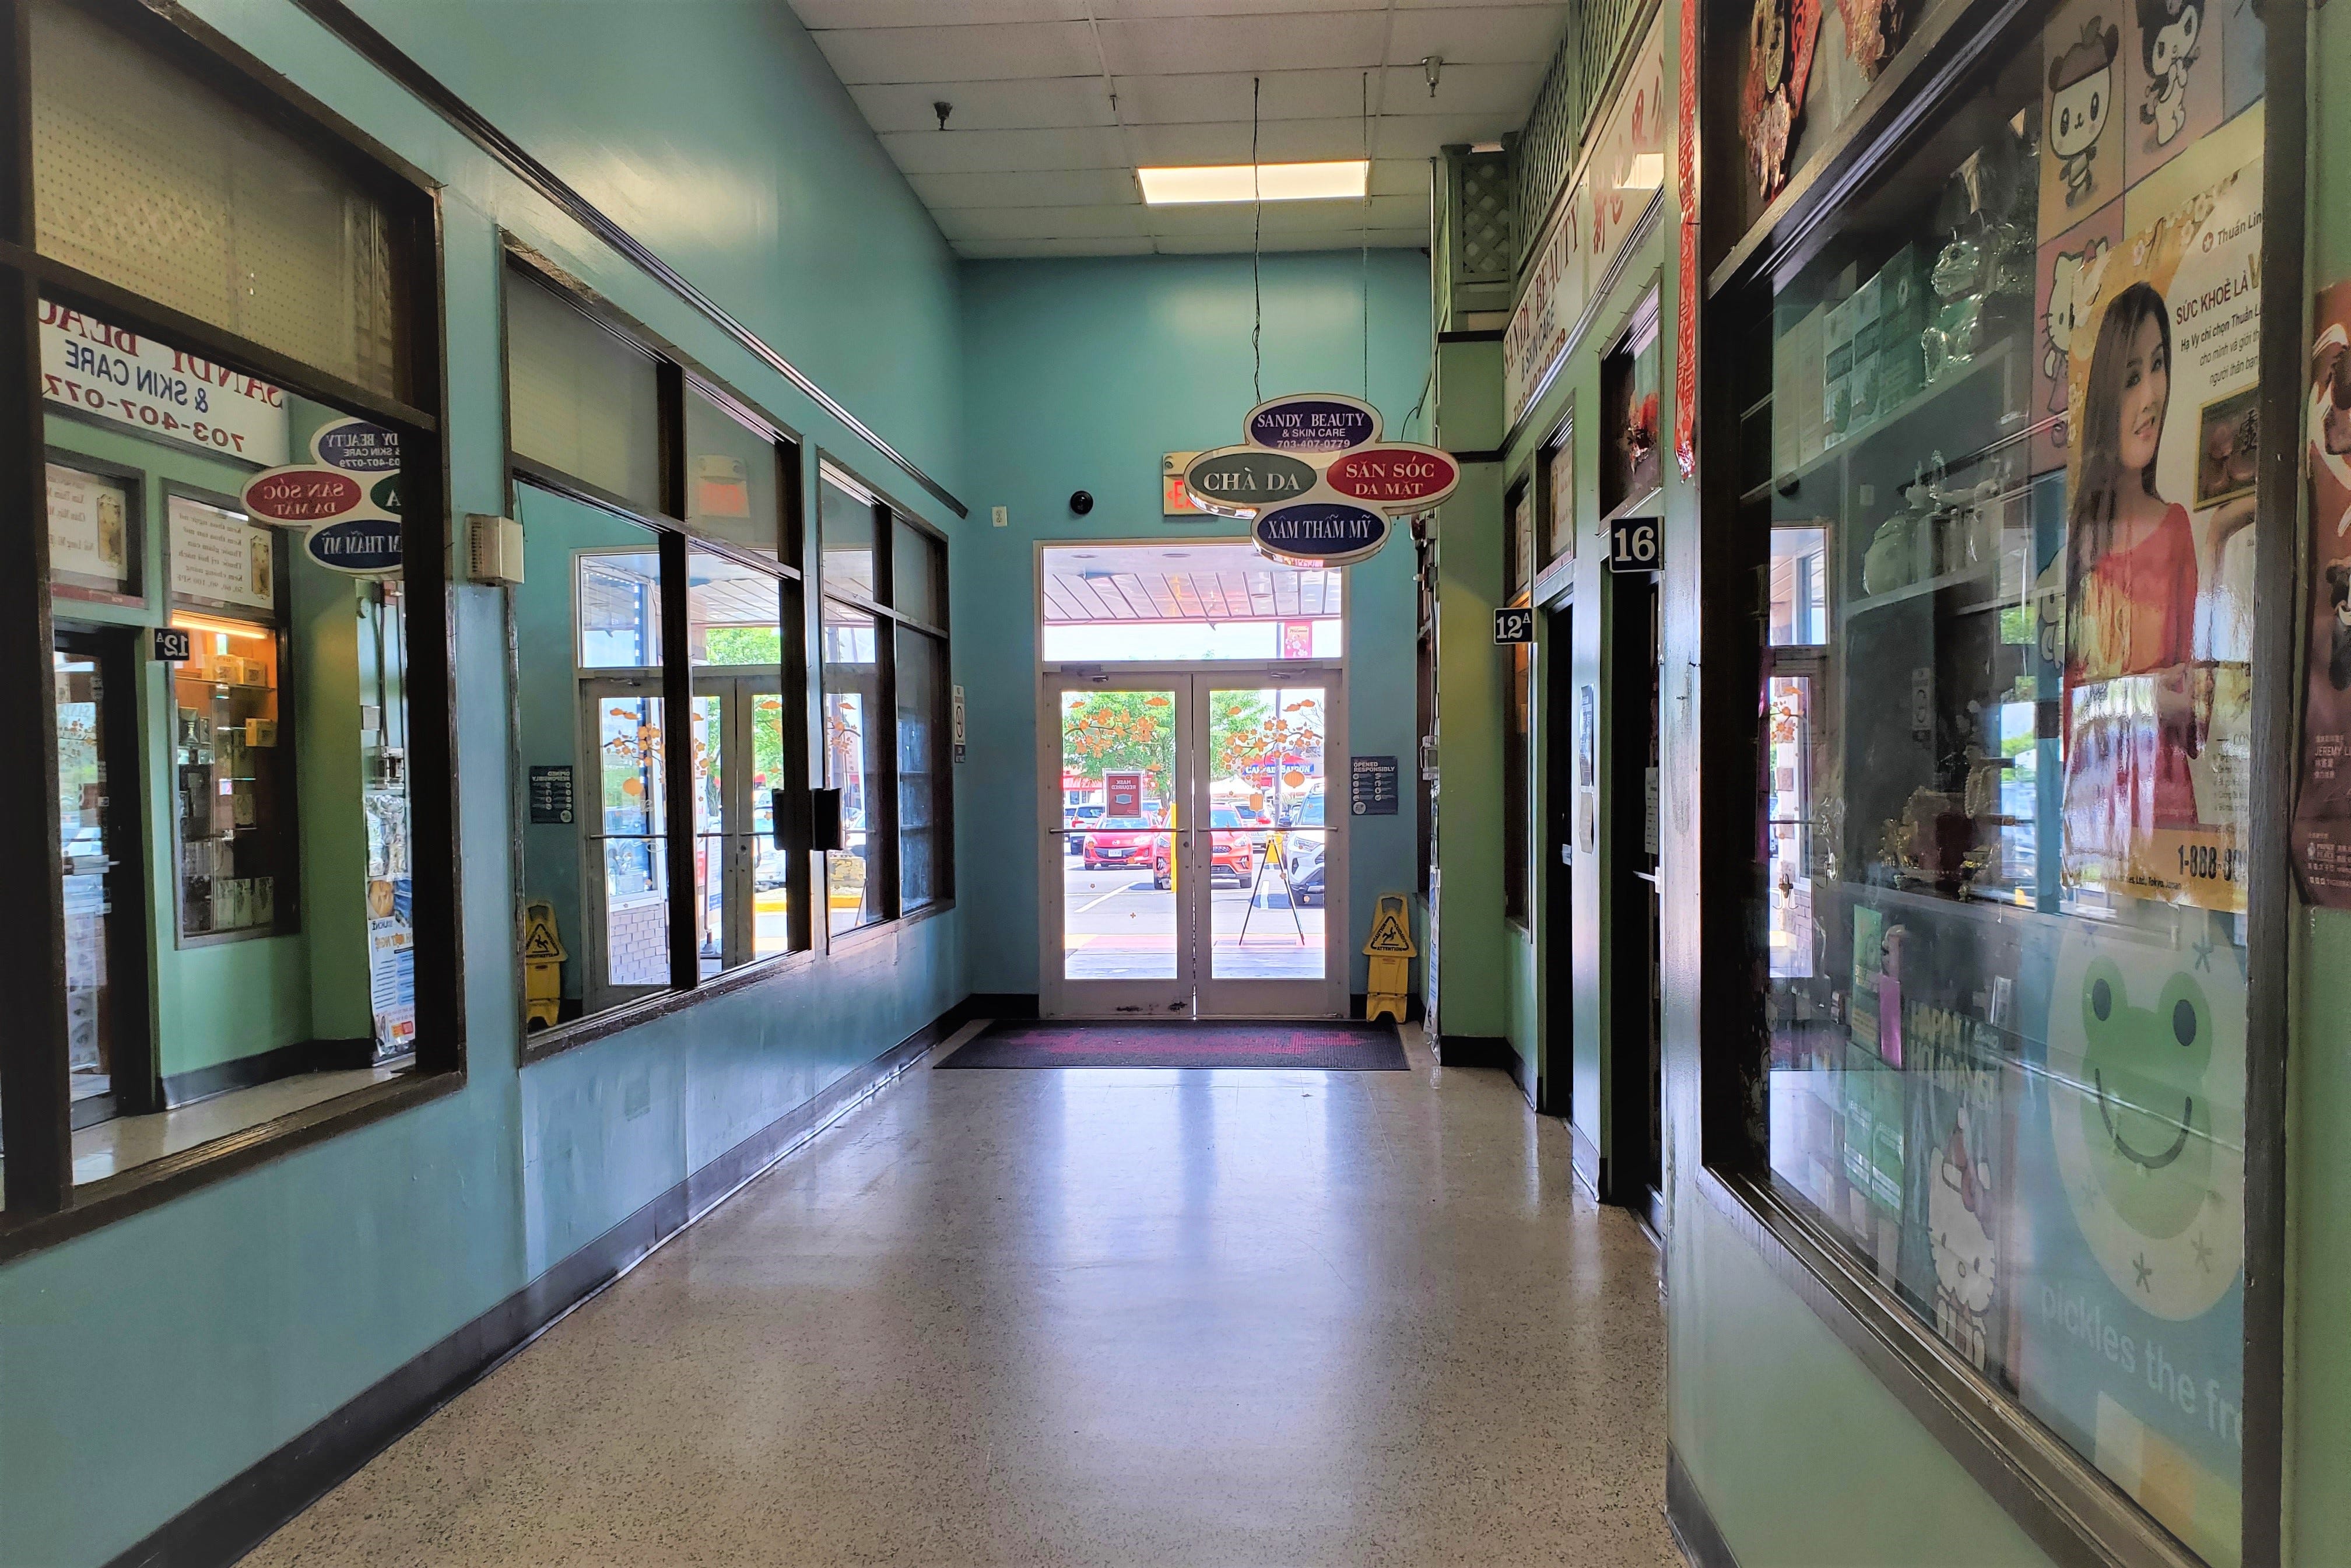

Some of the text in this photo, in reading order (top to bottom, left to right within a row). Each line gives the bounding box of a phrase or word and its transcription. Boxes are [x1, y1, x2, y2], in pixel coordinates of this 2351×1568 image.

[1536, 206, 1578, 321] BEAUTY
[1538, 300, 1555, 343] CARE
[1258, 413, 1365, 427] SANDY BEAUTY
[1277, 440, 1350, 448] 703-407-0779
[1282, 428, 1346, 437] & SKIN CARE
[1346, 455, 1434, 478] SĂN SÓC
[1203, 466, 1301, 491] CHÀ DA
[1355, 483, 1378, 495] DA
[1268, 515, 1299, 539] XÂM
[1349, 514, 1371, 538] MỸ
[1615, 527, 1655, 562] 16
[2315, 746, 2342, 756] JEREMY
[1373, 922, 1387, 942] CAUTION
[2041, 1283, 2135, 1373] pickles
[2145, 1340, 2196, 1415] the
